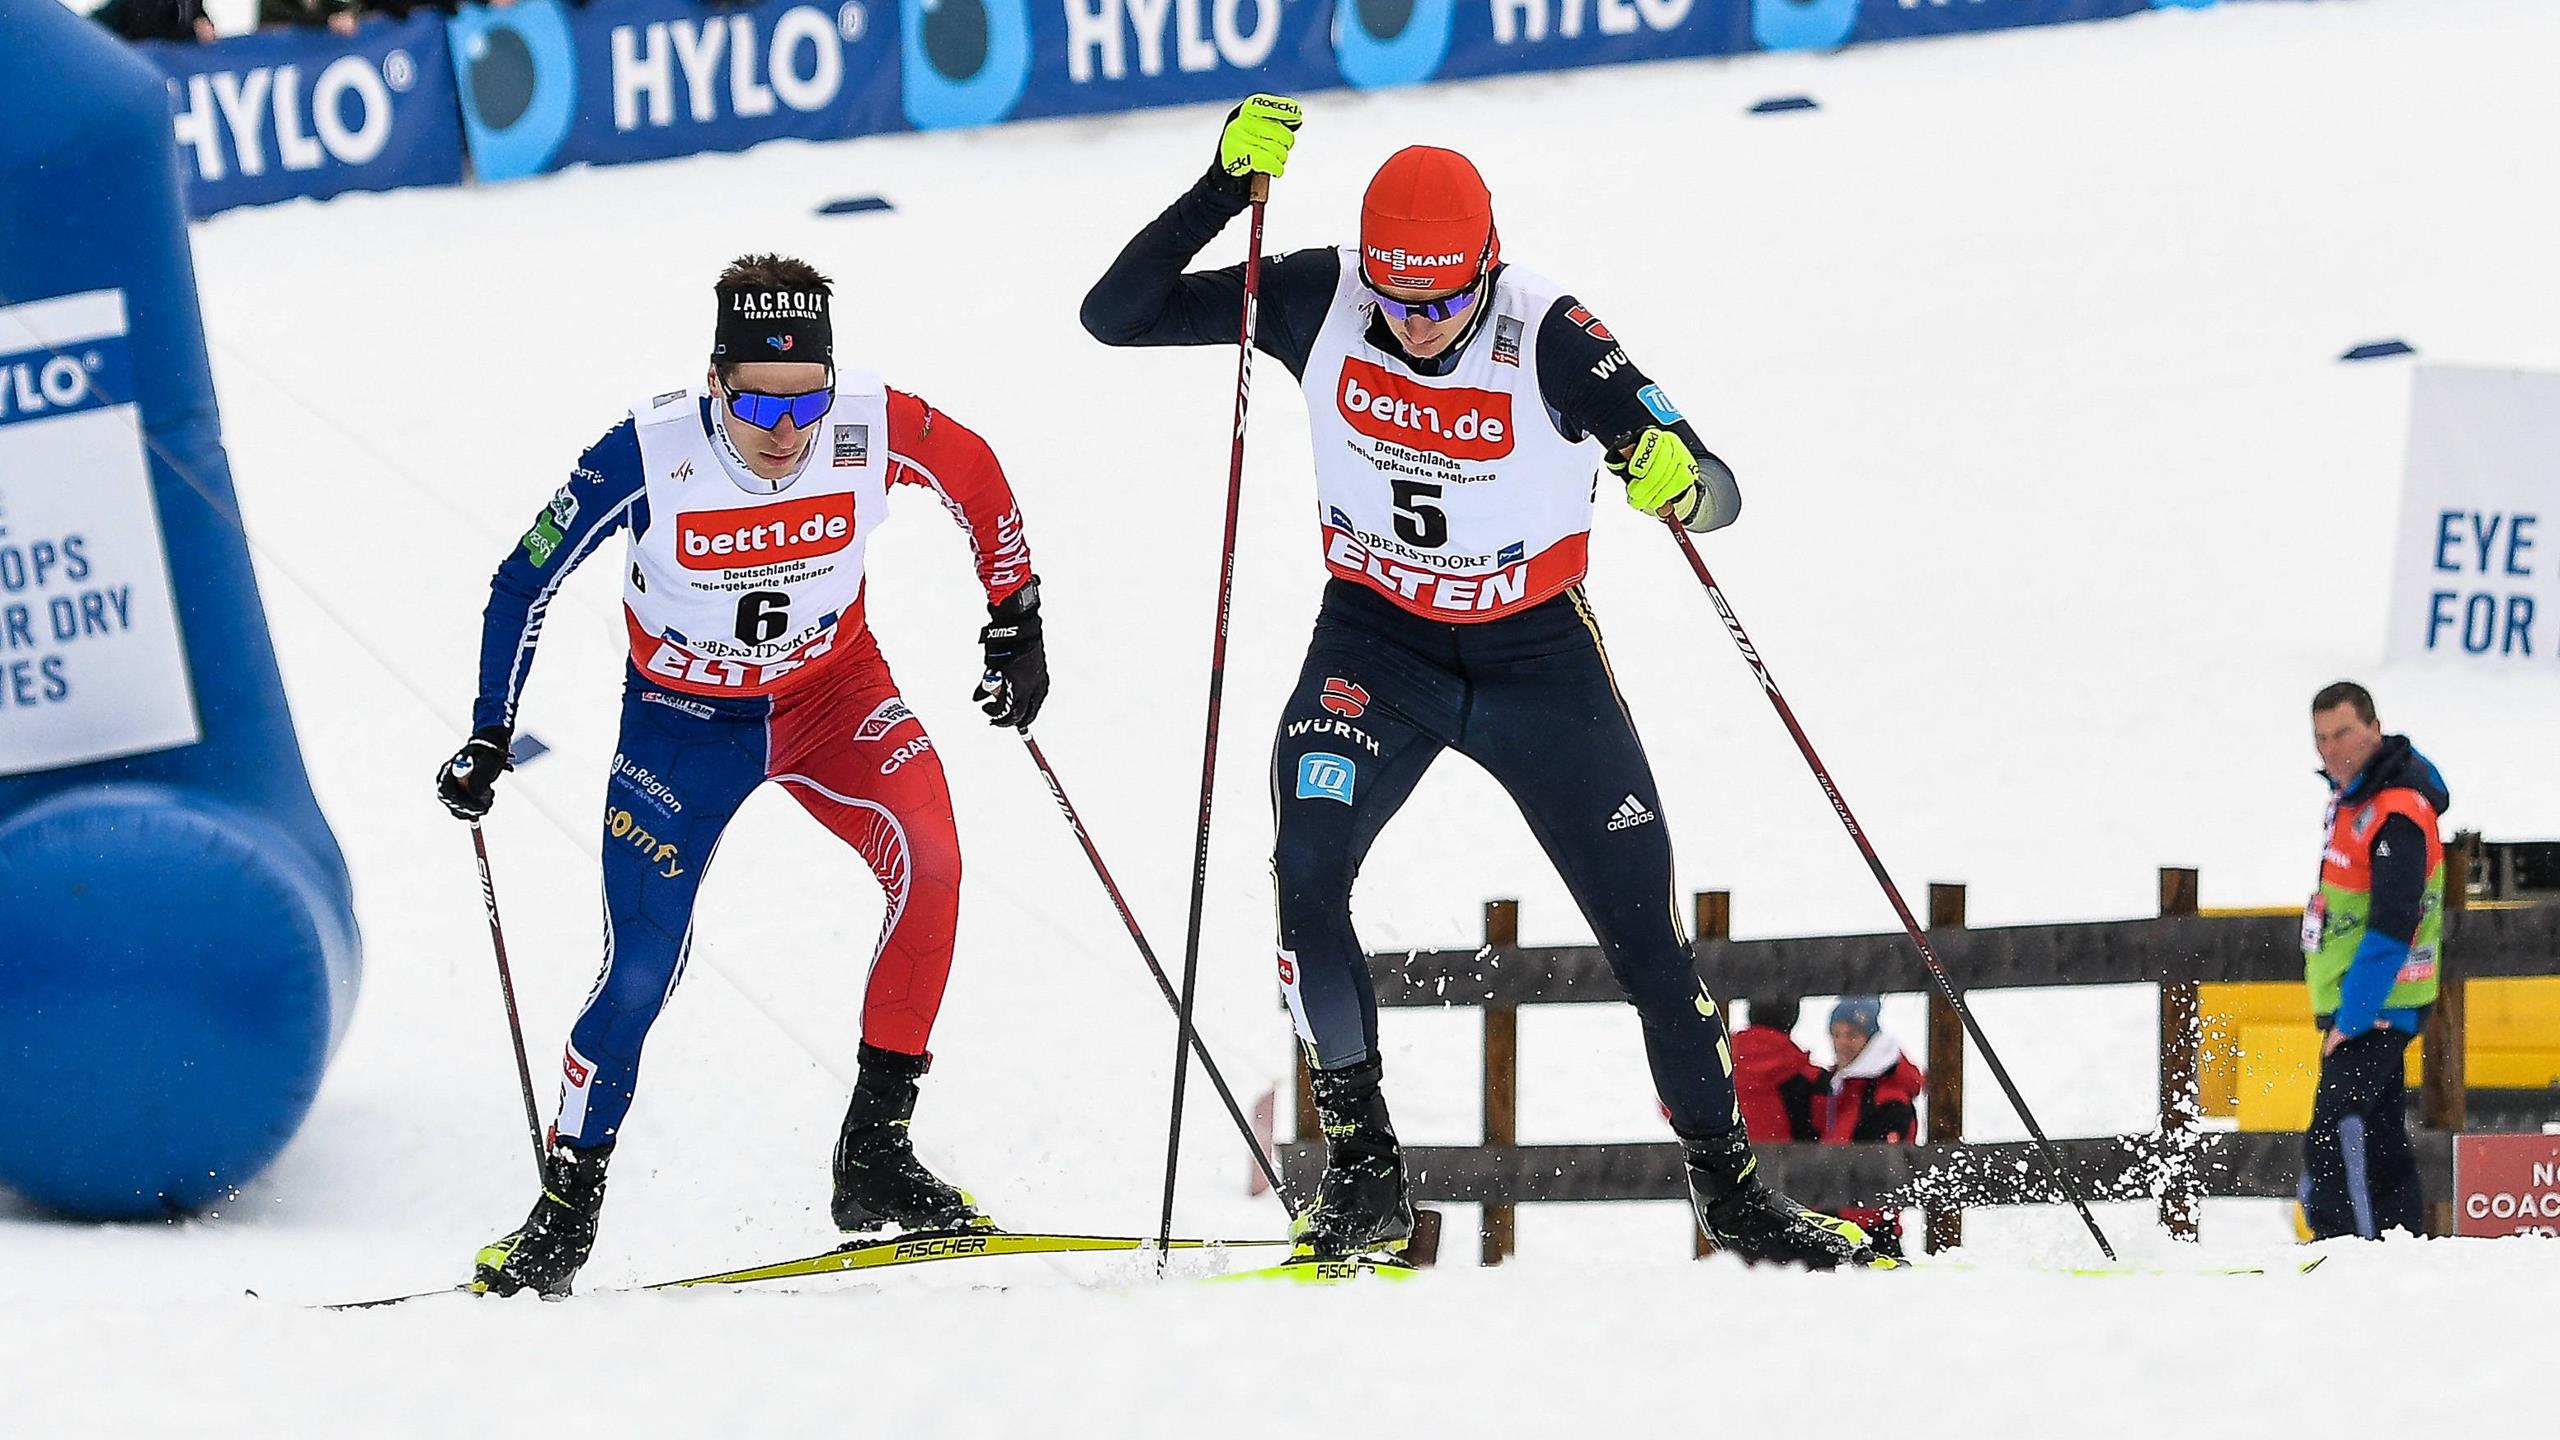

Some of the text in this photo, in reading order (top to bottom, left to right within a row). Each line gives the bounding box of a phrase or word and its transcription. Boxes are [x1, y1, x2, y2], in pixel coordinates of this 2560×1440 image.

[732, 291, 823, 313] LACROIX
[1344, 377, 1505, 443] bett1.de
[1374, 440, 1462, 471] Deutschlands
[1437, 468, 1497, 485] Matratze
[684, 513, 848, 557] bett1.de
[1390, 479, 1449, 550] 5
[1357, 530, 1492, 571] OBERSTDORF
[2434, 510, 2536, 576] EYE
[723, 560, 807, 581] Deutschlands
[784, 564, 835, 585] Matratze
[1327, 531, 1529, 611] ELTEN
[50, 584, 130, 642] DRY
[734, 590, 791, 648] 6
[2425, 591, 2536, 657] FOR
[1287, 718, 1380, 757] WÜRTH
[1607, 810, 1655, 832] adidas
[604, 806, 685, 879] somfy
[894, 1237, 987, 1261] FISCHER
